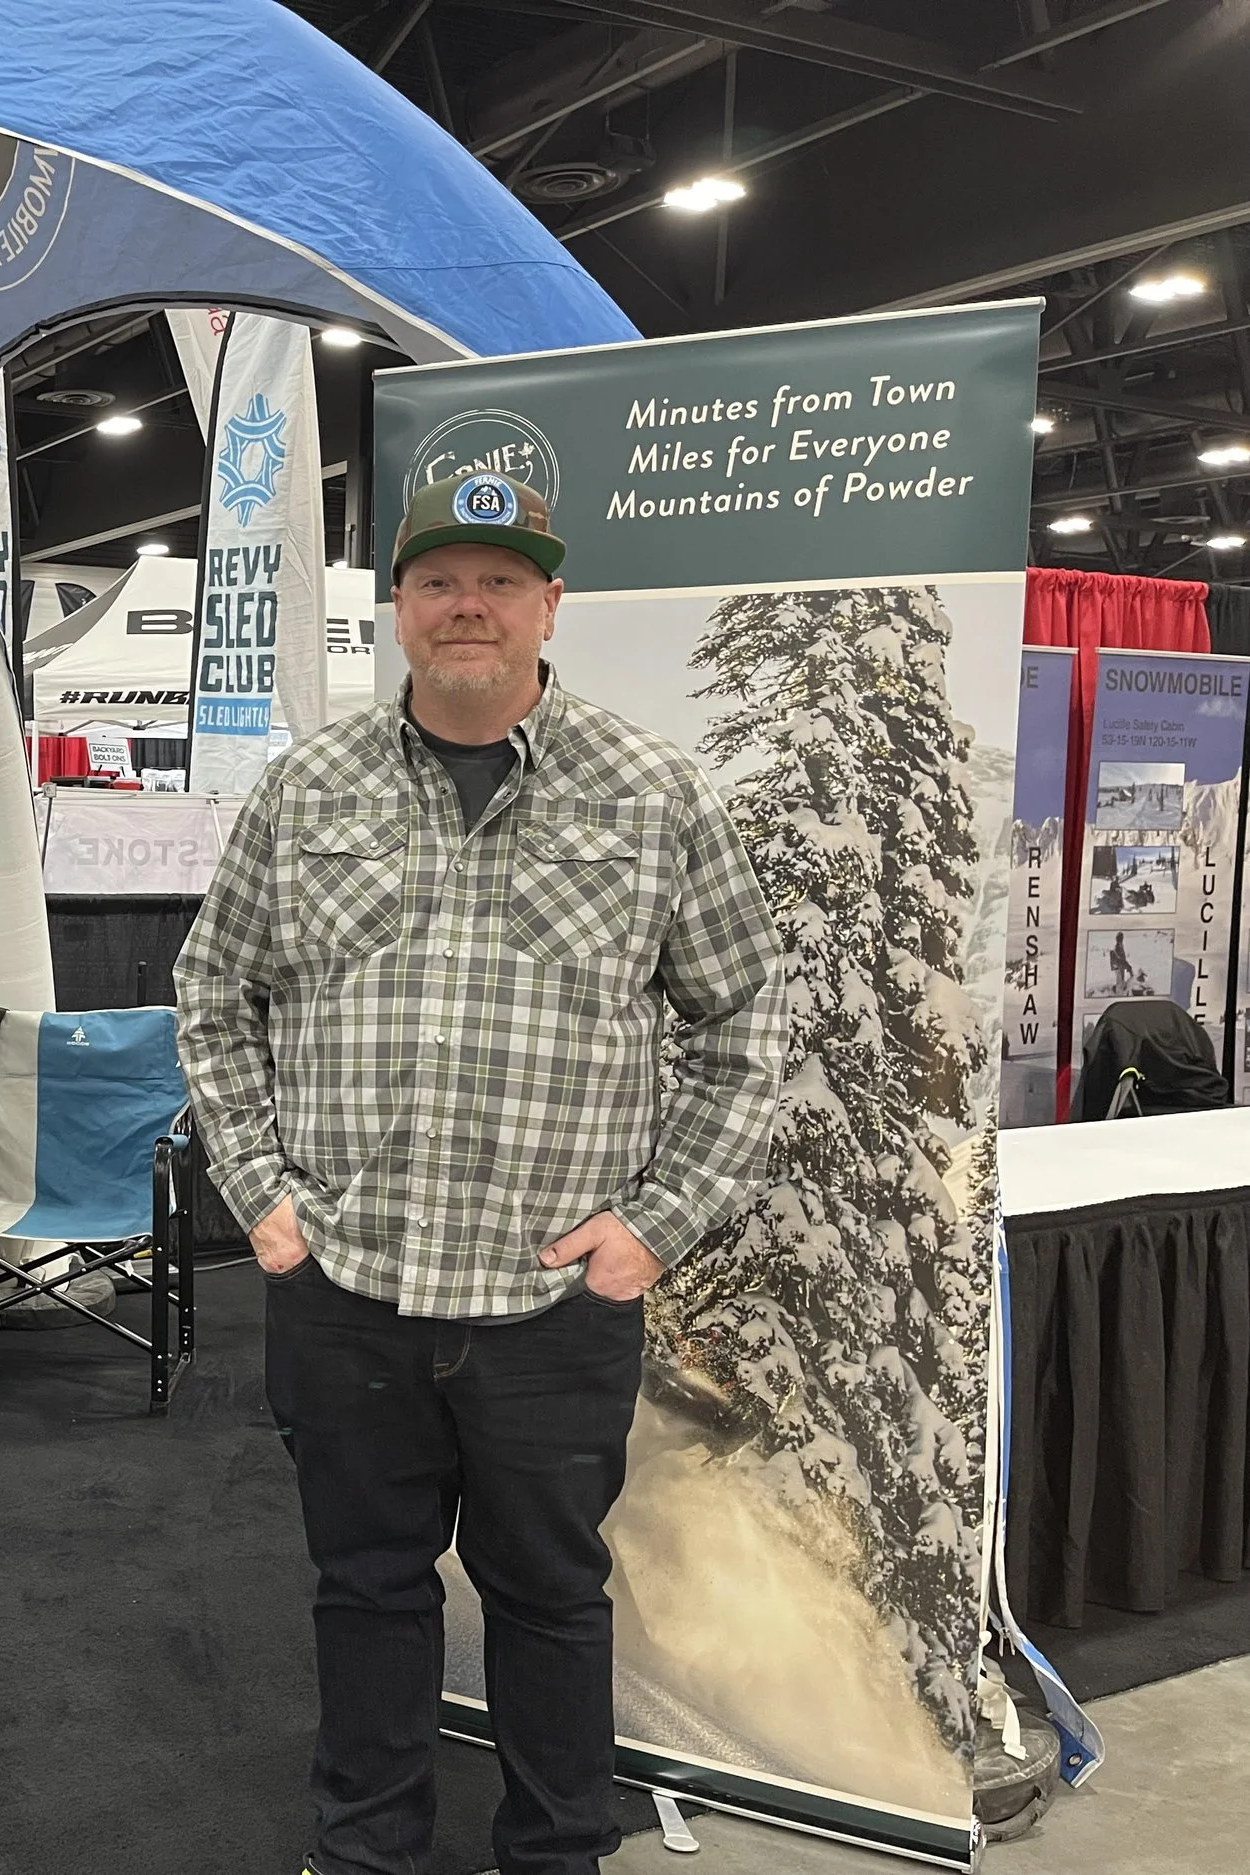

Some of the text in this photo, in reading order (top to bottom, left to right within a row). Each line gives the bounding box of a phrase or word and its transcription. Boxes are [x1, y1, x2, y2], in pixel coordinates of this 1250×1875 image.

[626, 375, 956, 429] Minutes from Town
[628, 429, 951, 478] Miles for Everyone
[473, 495, 499, 511] FSA
[606, 468, 974, 520] Mountains of Powder
[209, 544, 281, 587] REVY
[204, 591, 277, 648] SLED
[199, 654, 275, 692] CLUB
[1106, 669, 1242, 697] SNOWMOBILE
[60, 691, 190, 704] #RUNB
[1020, 847, 1041, 1045] RENSHAW
